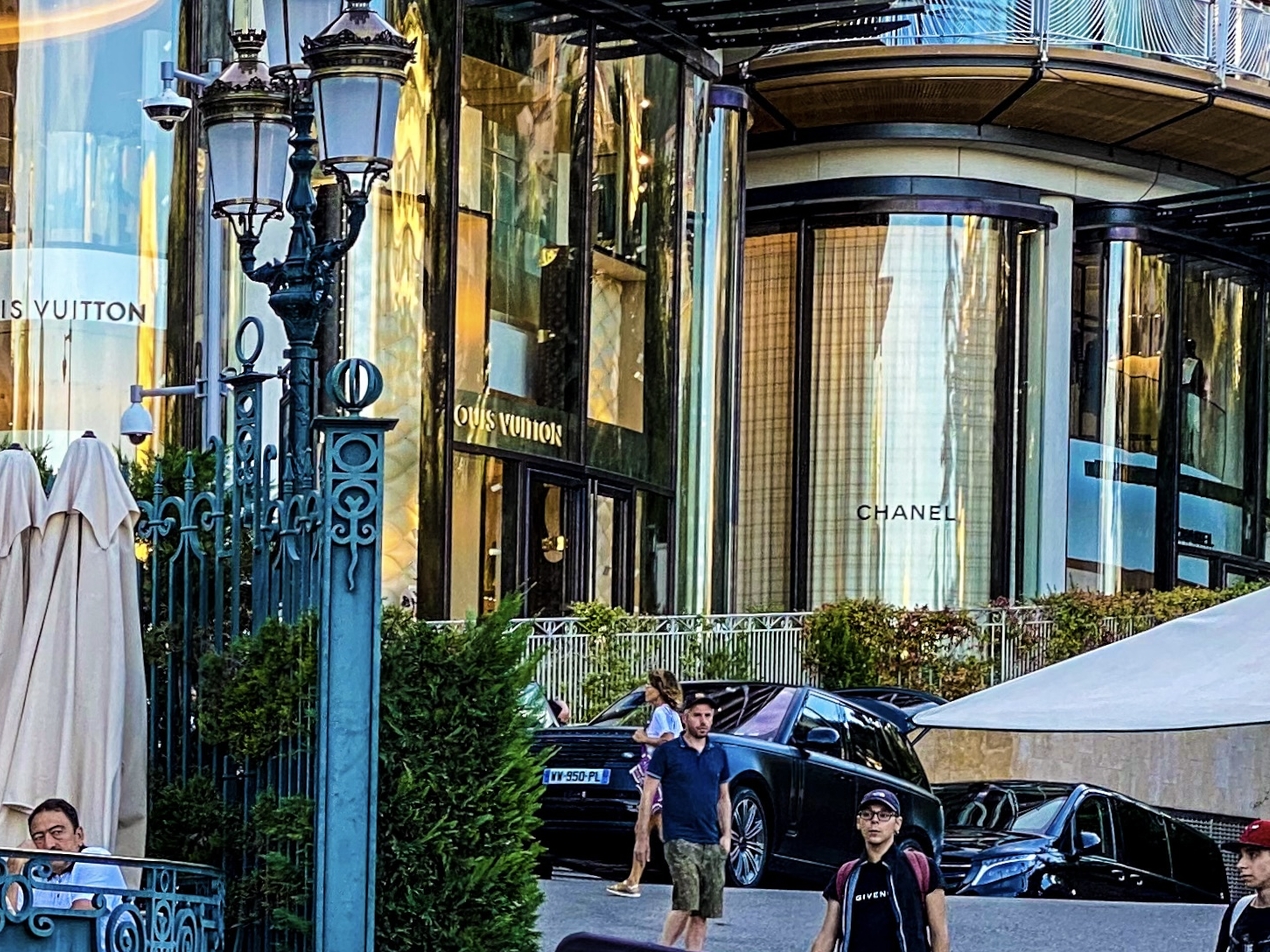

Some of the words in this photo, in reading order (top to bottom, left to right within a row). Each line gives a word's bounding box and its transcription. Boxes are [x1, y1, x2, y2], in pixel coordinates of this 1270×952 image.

[34, 299, 146, 323] VUITTON
[856, 504, 956, 521] CHANEL
[855, 890, 890, 902] GIVEN
